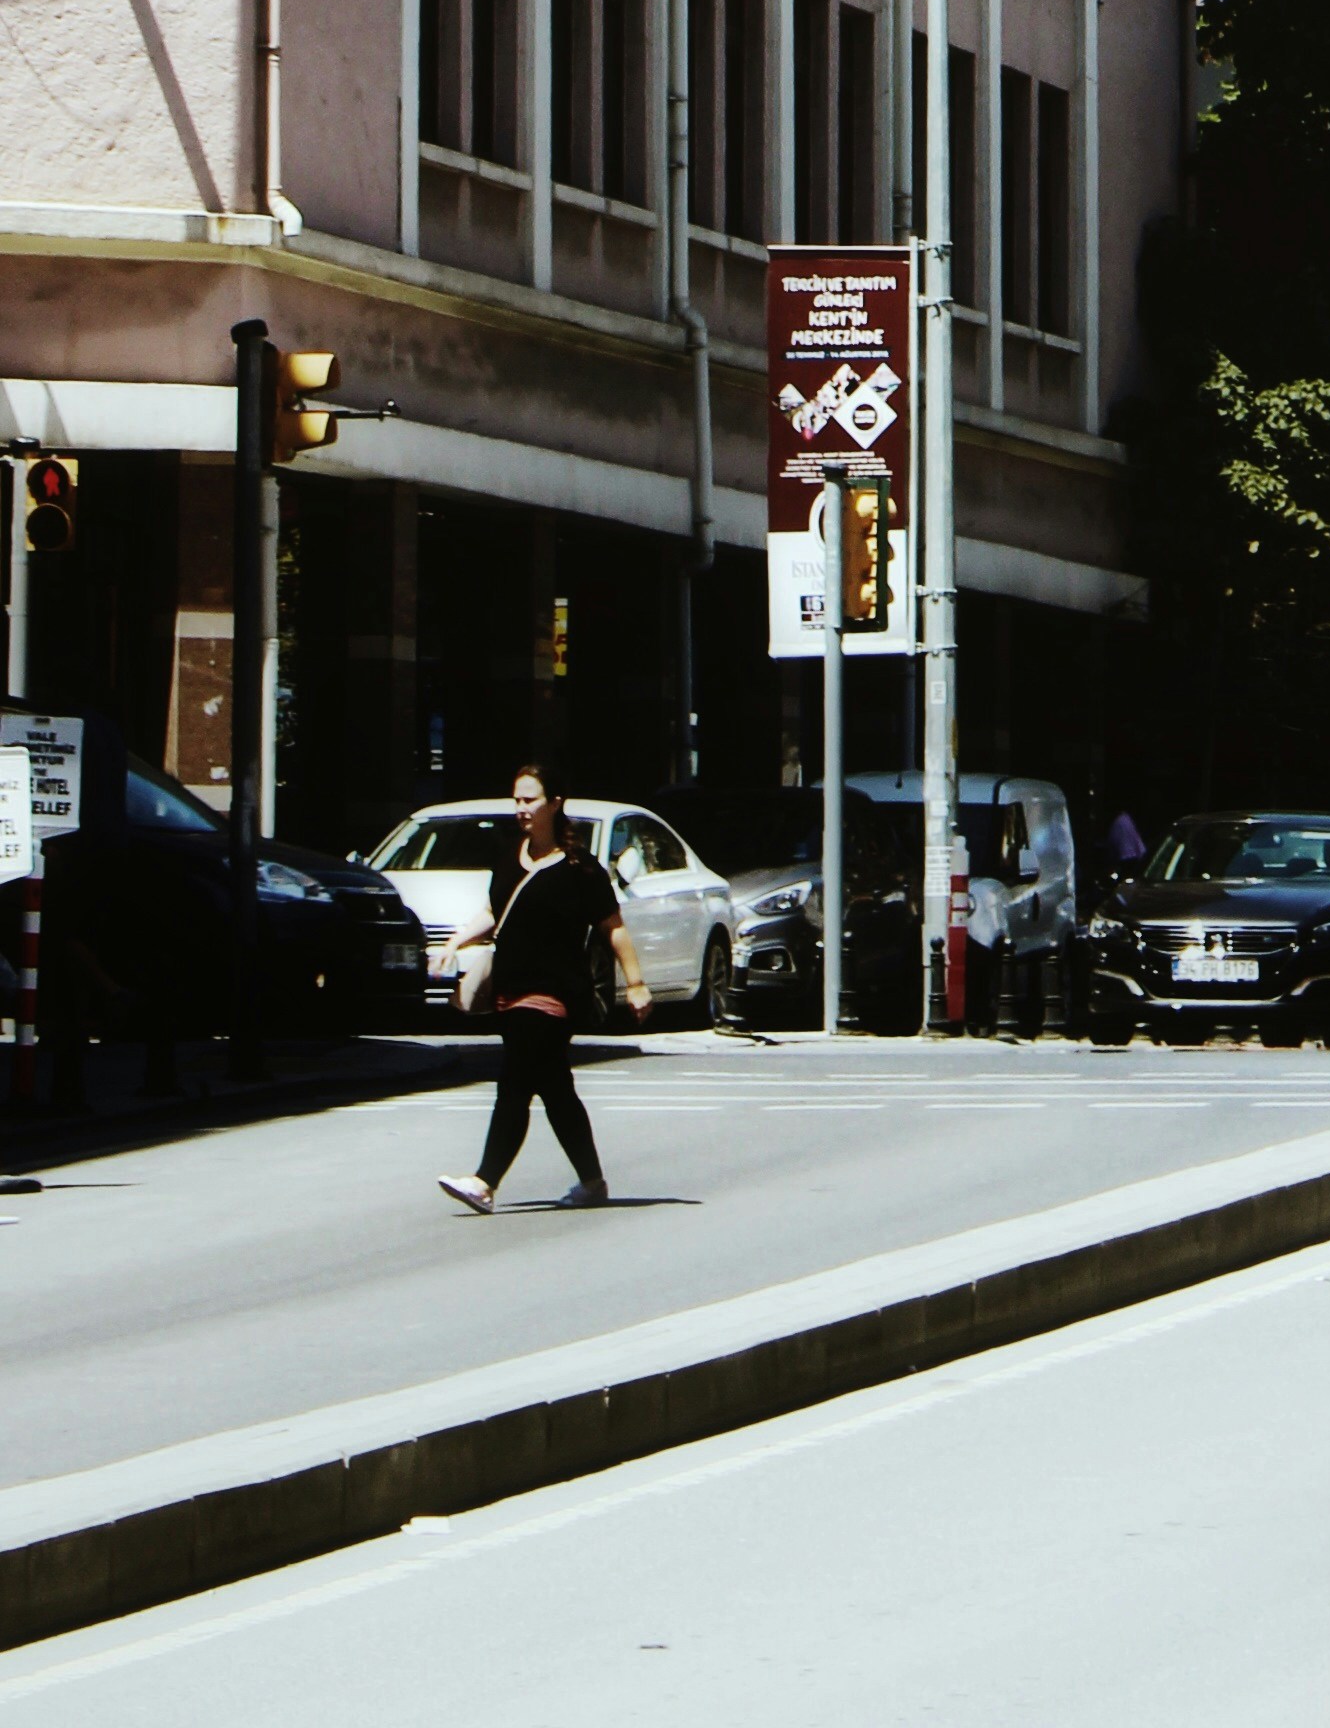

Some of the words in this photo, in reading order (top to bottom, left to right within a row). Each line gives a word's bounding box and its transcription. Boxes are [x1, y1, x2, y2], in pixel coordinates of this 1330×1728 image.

[827, 277, 844, 292] VE
[845, 276, 897, 291] TANITIM
[813, 292, 864, 308] GÜNLERİ
[808, 308, 868, 326] KENT'İN
[791, 327, 884, 345] MERKEZİNDE
